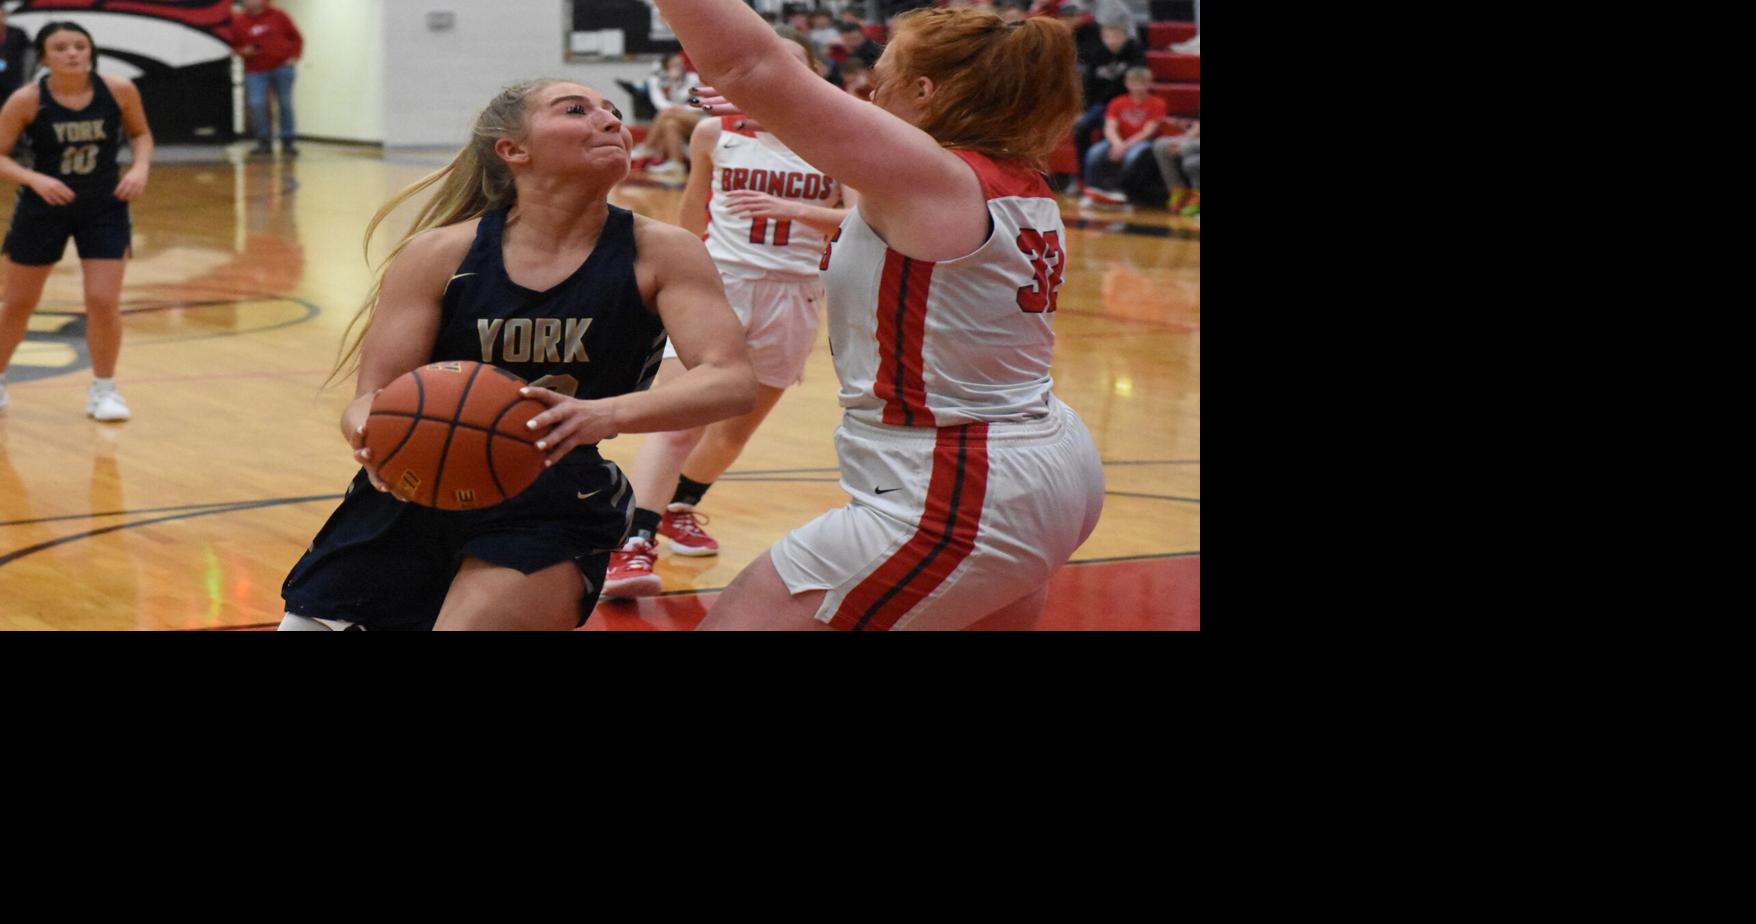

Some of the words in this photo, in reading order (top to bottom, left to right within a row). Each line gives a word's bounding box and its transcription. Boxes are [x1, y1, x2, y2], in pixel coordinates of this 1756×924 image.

[53, 120, 106, 142] YORK
[60, 144, 99, 175] 10
[721, 168, 834, 200] BRONCOS
[749, 216, 791, 246] 11
[1016, 228, 1064, 314] 32
[477, 318, 593, 363] YORK
